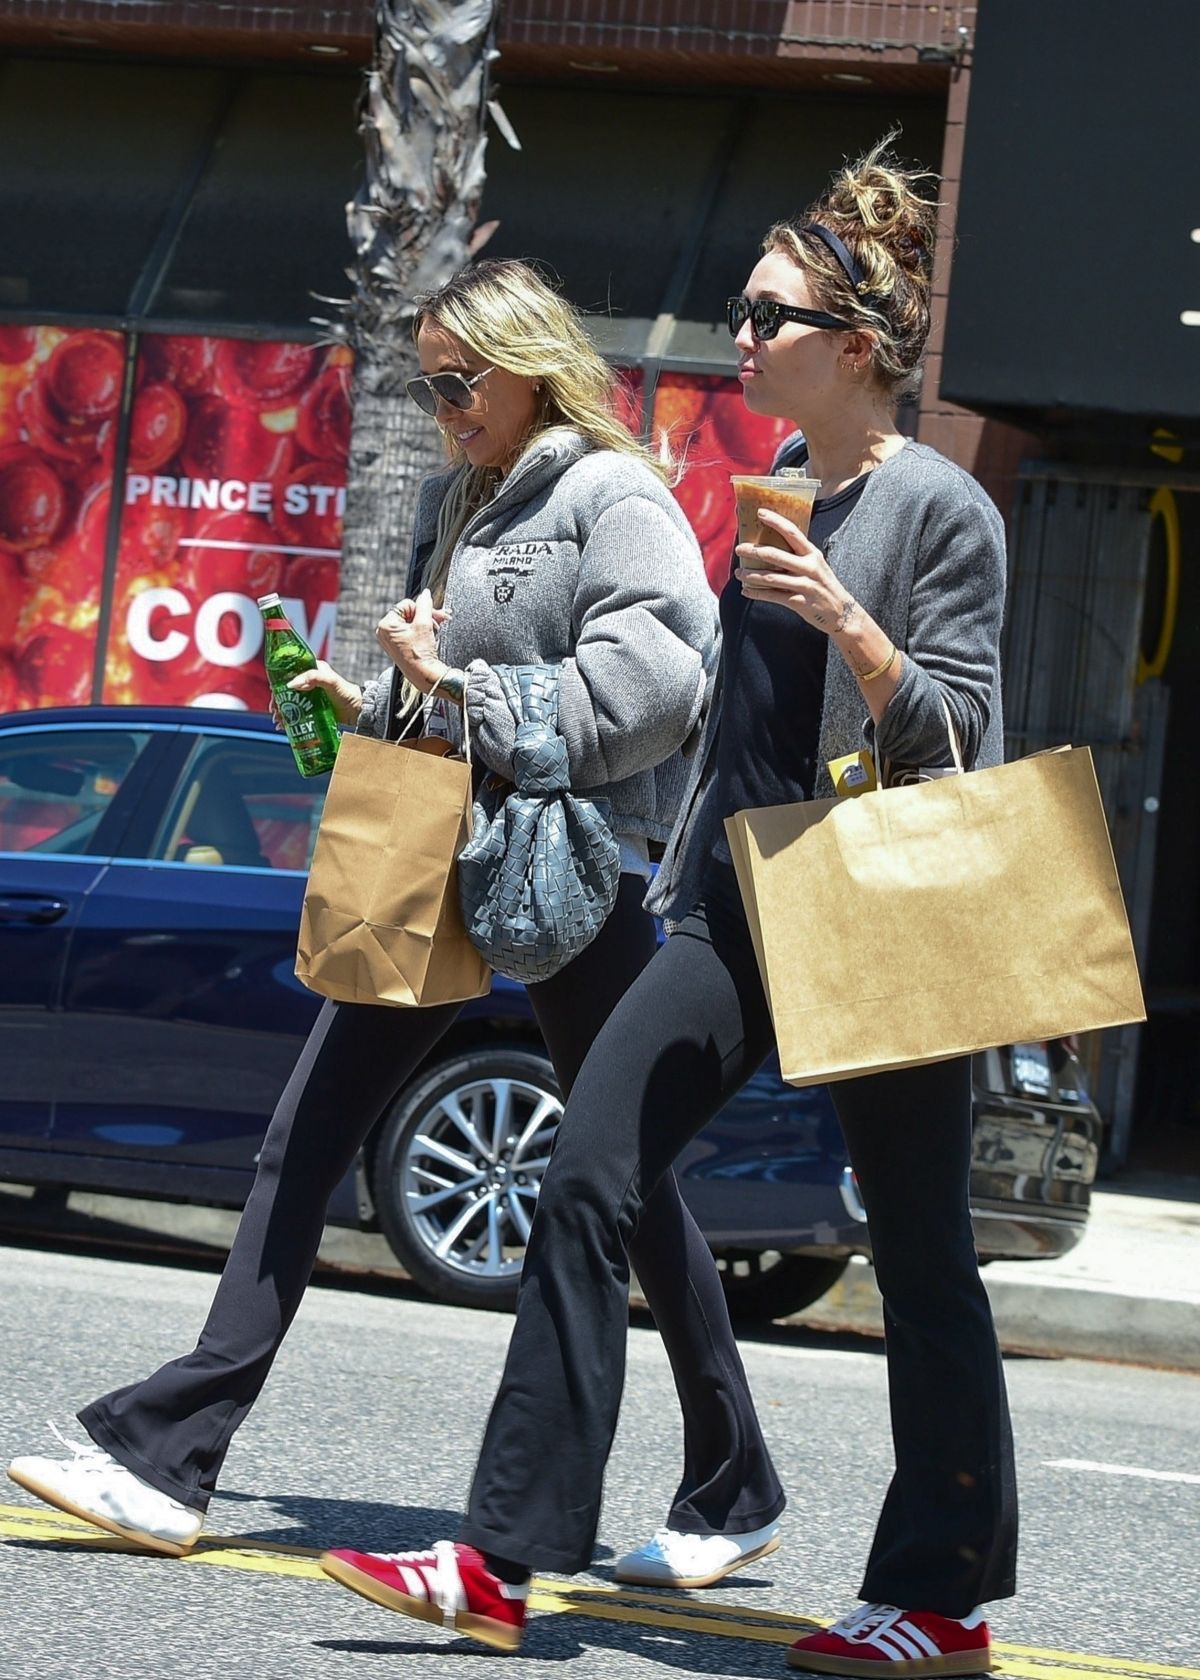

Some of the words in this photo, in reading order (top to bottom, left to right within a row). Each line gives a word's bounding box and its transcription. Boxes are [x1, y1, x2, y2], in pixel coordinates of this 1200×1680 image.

[126, 474, 273, 513] PRINCE
[489, 543, 553, 555] RADA
[493, 556, 532, 566] MILANO
[291, 721, 315, 737] LLEY
